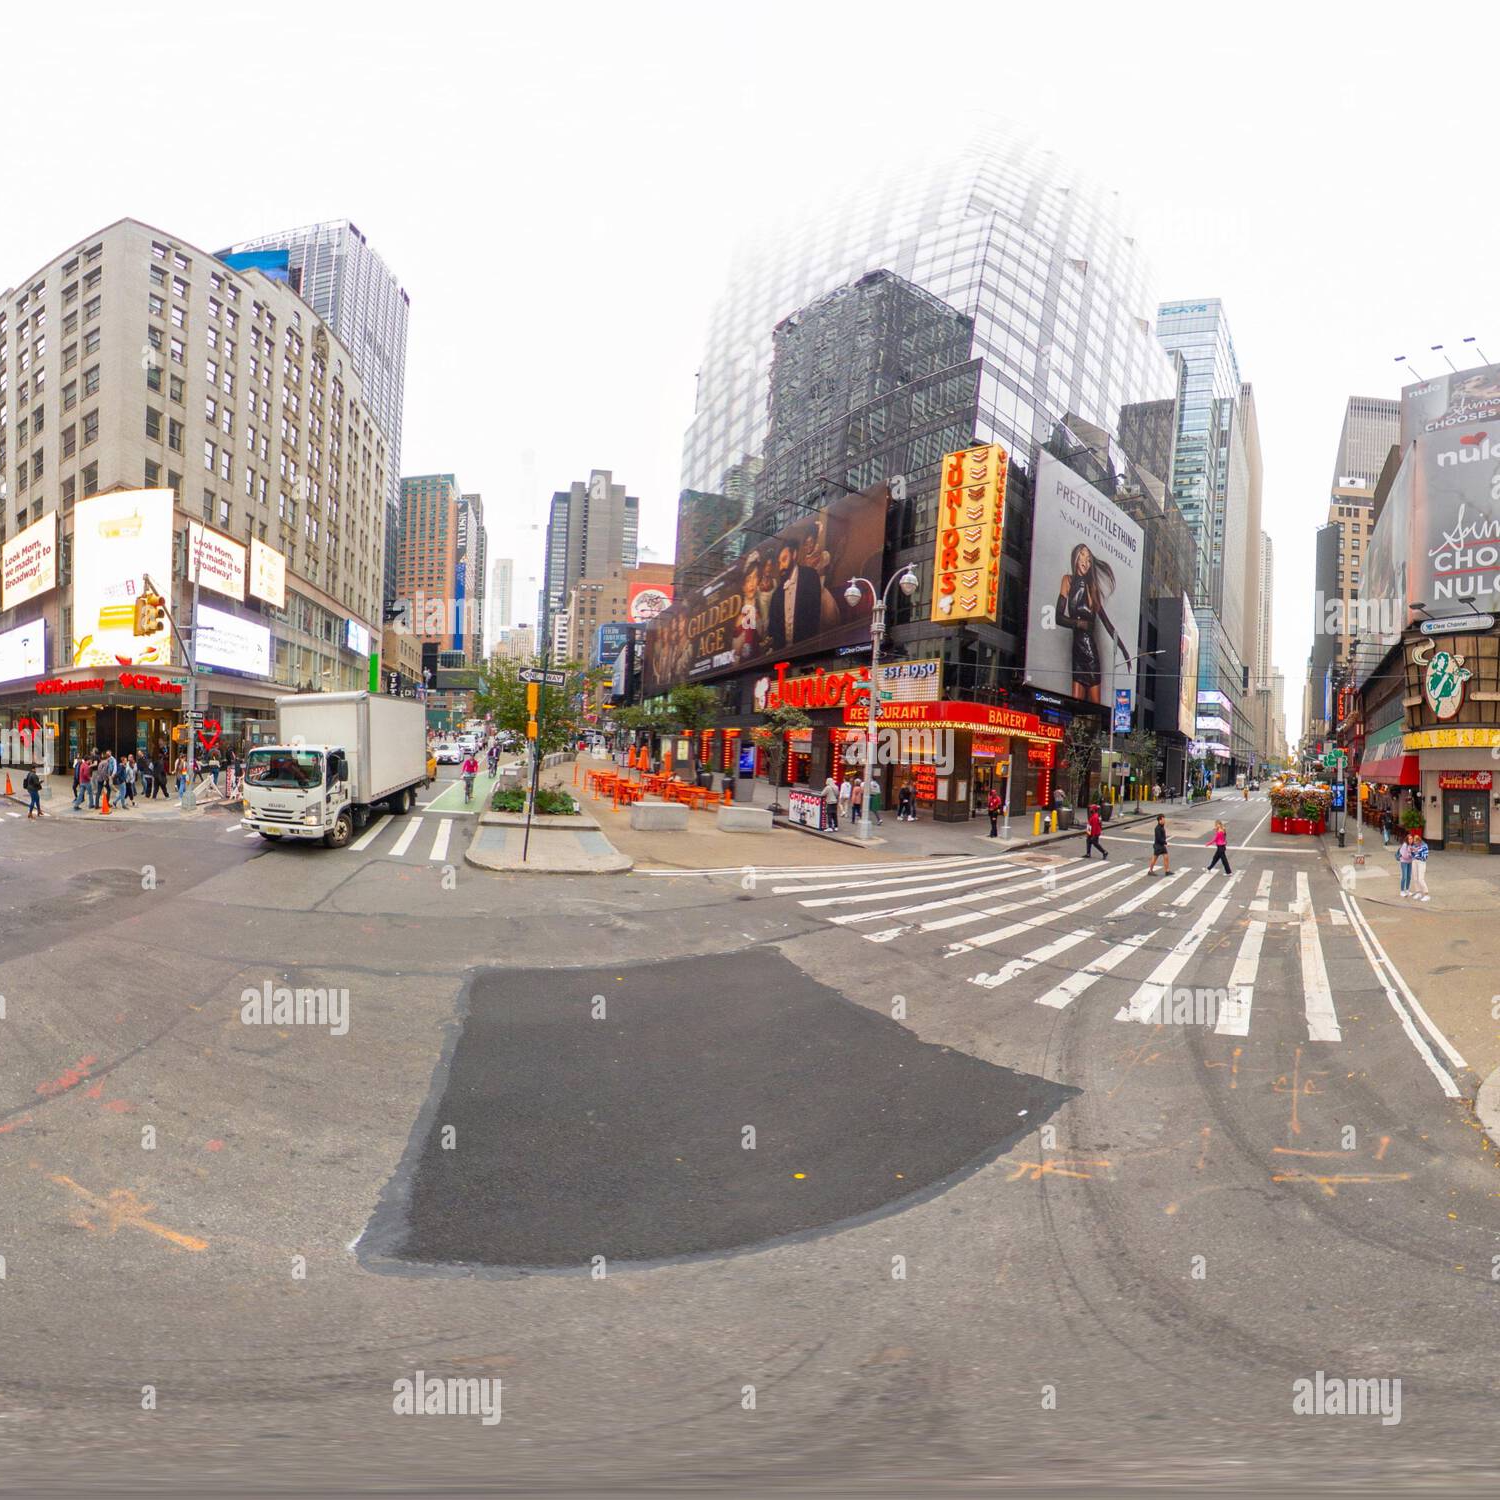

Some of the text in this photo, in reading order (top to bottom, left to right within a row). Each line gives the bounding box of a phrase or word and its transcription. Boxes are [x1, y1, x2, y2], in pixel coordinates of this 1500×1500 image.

[1425, 408, 1497, 433] CHOOSES
[941, 452, 965, 596] JUNIORS
[1056, 480, 1137, 553] PRETTYLITTLETHING
[1060, 510, 1090, 537] NAOMI
[5, 551, 20, 568] Look
[5, 567, 14, 578] we
[15, 556, 34, 572] made
[43, 545, 51, 557] to
[206, 553, 226, 568] made
[234, 564, 242, 574] to
[5, 562, 40, 590] Broadway!
[688, 594, 742, 639] GILDED
[698, 627, 725, 656] AGE
[546, 674, 562, 683] WAY
[905, 663, 936, 678] 1950
[133, 673, 161, 692] CVS
[850, 705, 929, 720] RESURANT
[988, 710, 1028, 729] BAKERY
[1038, 723, 1062, 738] KE-OUT
